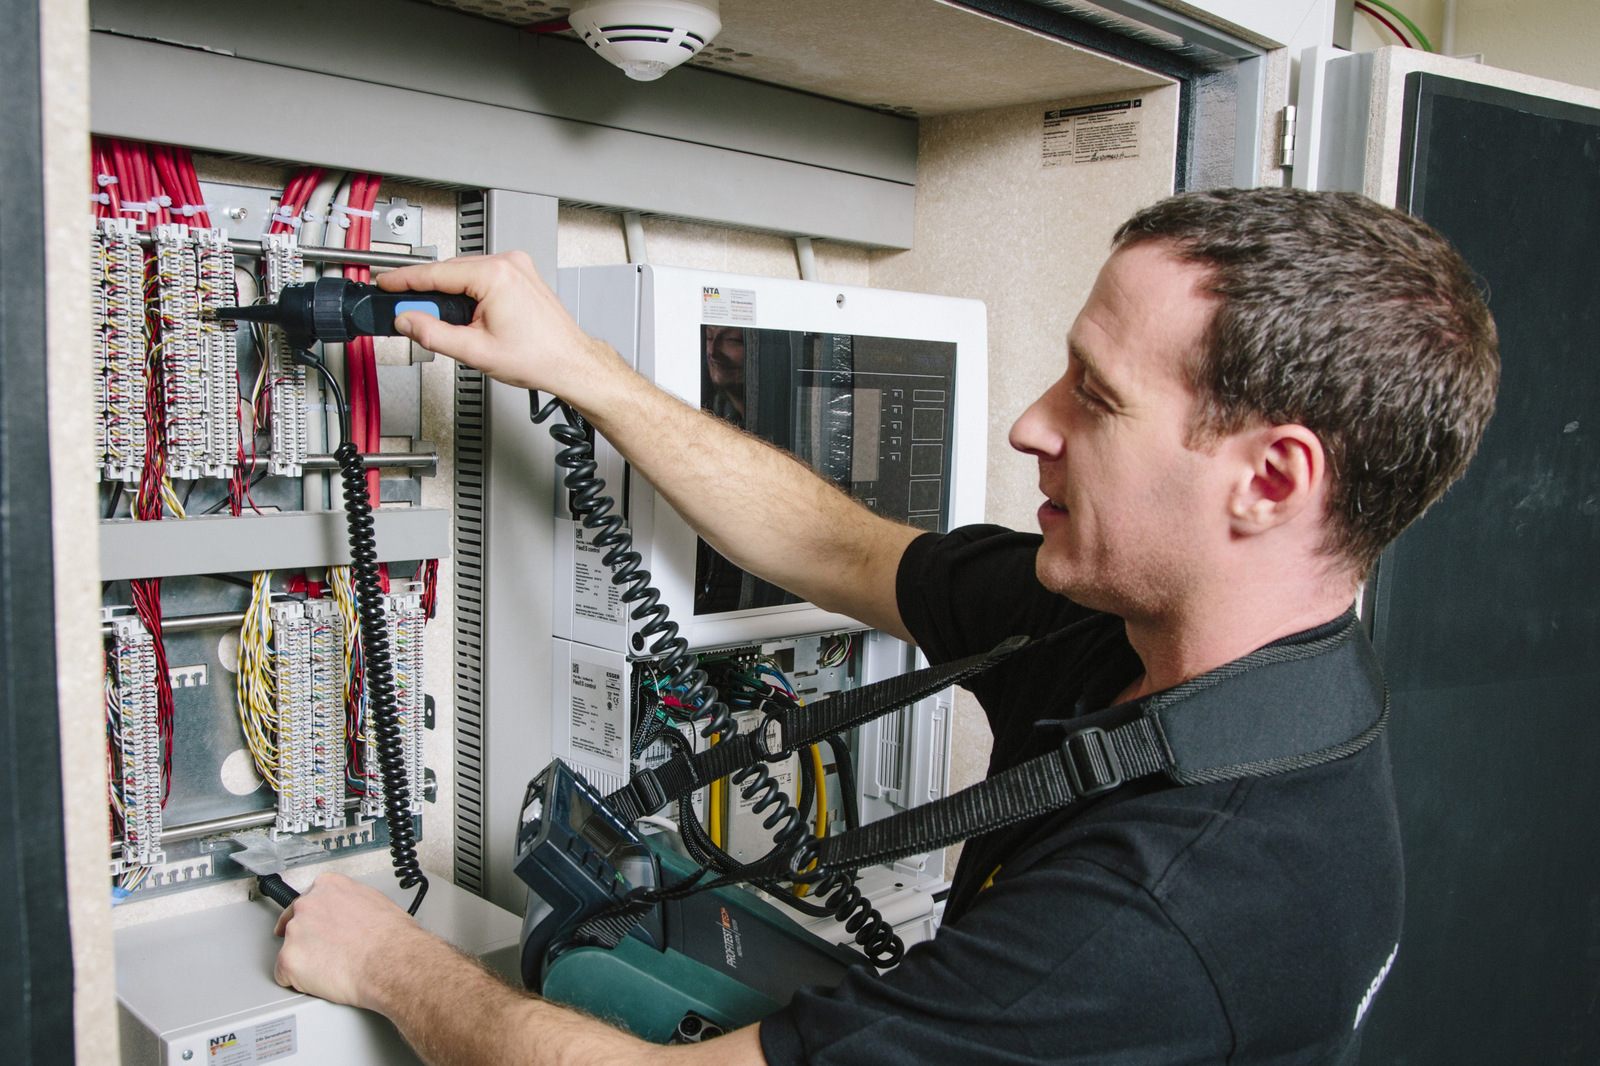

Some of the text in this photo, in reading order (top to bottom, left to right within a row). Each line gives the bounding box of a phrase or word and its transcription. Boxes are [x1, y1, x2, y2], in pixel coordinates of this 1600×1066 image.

[703, 287, 720, 295] NTA
[606, 671, 620, 680] ESSER
[210, 1032, 237, 1047] NTA
